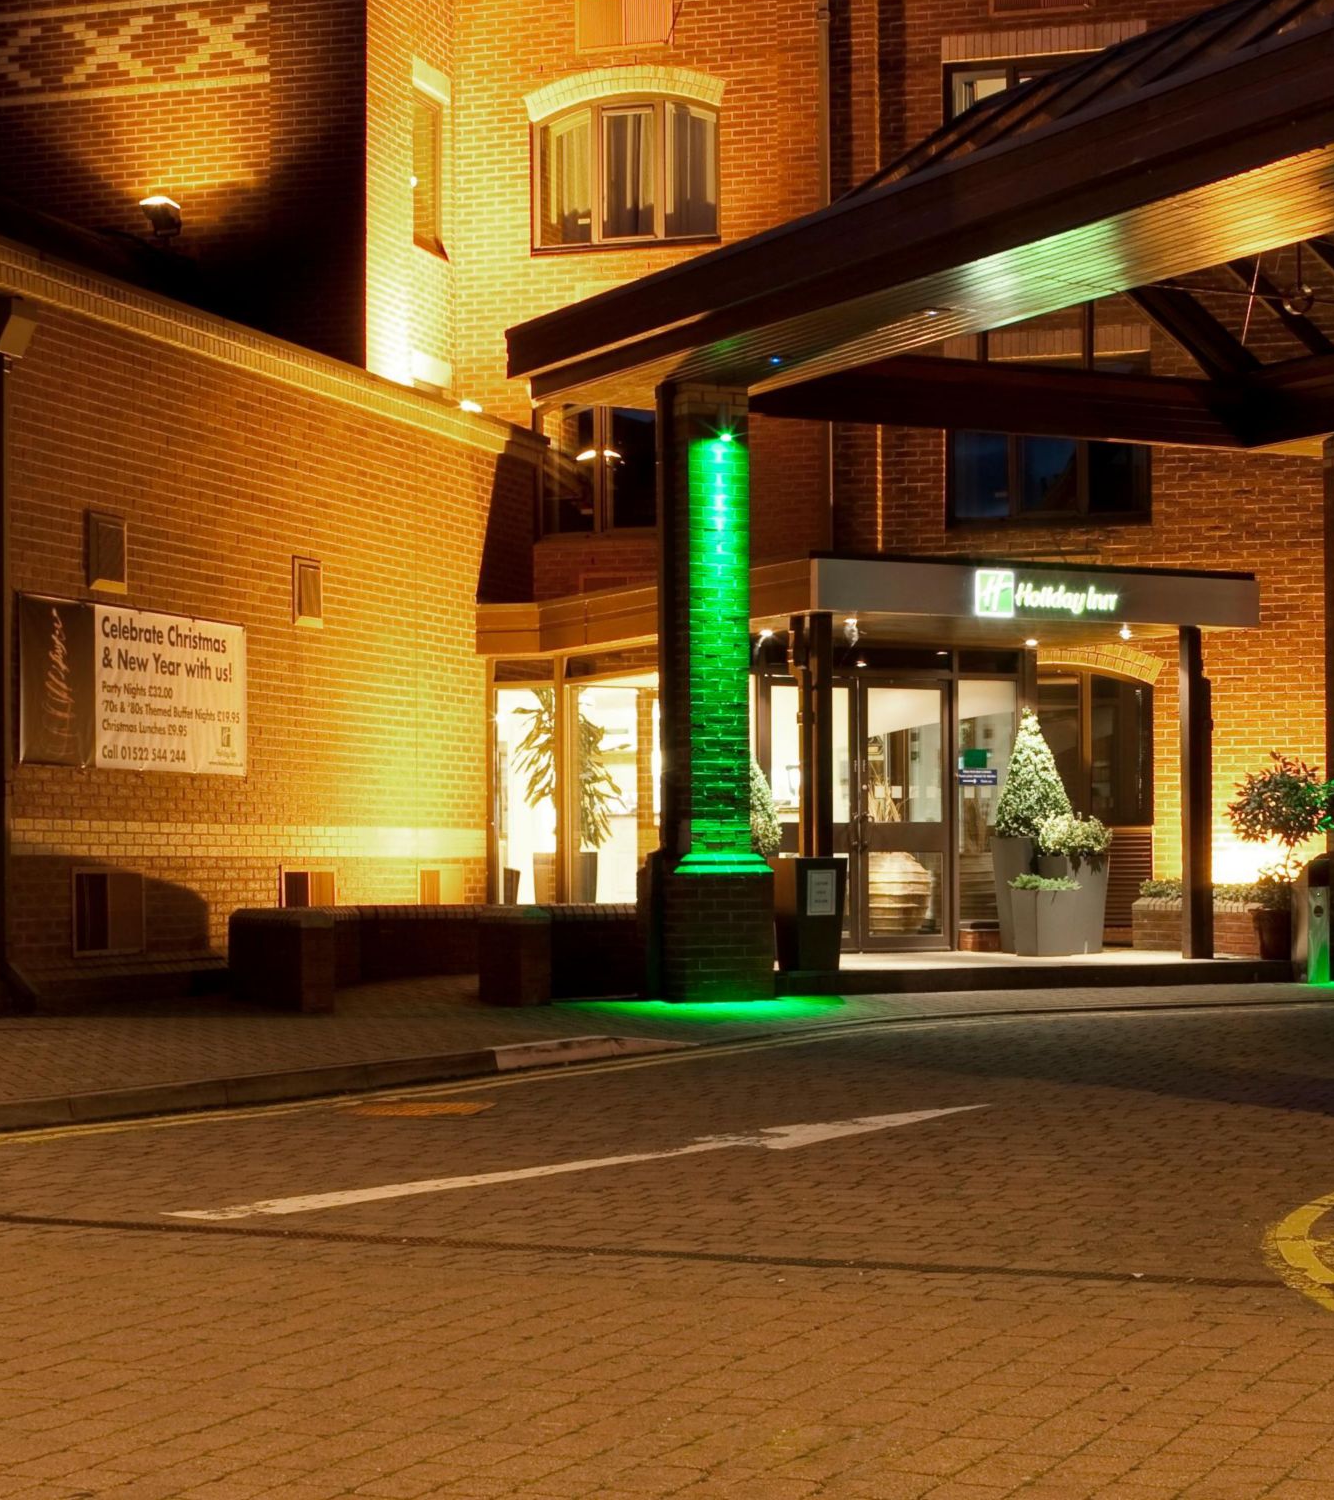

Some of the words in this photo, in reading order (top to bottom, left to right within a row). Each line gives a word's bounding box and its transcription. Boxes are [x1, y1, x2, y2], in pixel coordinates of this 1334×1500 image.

[1015, 582, 1086, 614] Holiday
[1087, 585, 1118, 611] Inn
[101, 615, 164, 645] Celebrate
[167, 624, 227, 653] Christmas
[101, 646, 113, 669] &
[117, 648, 149, 673] New
[152, 653, 181, 676] Year
[184, 657, 212, 680] with
[215, 662, 232, 683] us!
[101, 680, 121, 697] Party
[123, 682, 147, 699] Nights
[148, 685, 173, 700] £32.00
[120, 701, 126, 713] &
[145, 703, 172, 718] Themed
[173, 706, 193, 719] Buffet
[194, 709, 215, 723] Nights
[101, 718, 137, 733] Christmas
[138, 721, 166, 735] Lunches
[101, 745, 118, 760] Call
[121, 746, 149, 761] 01522
